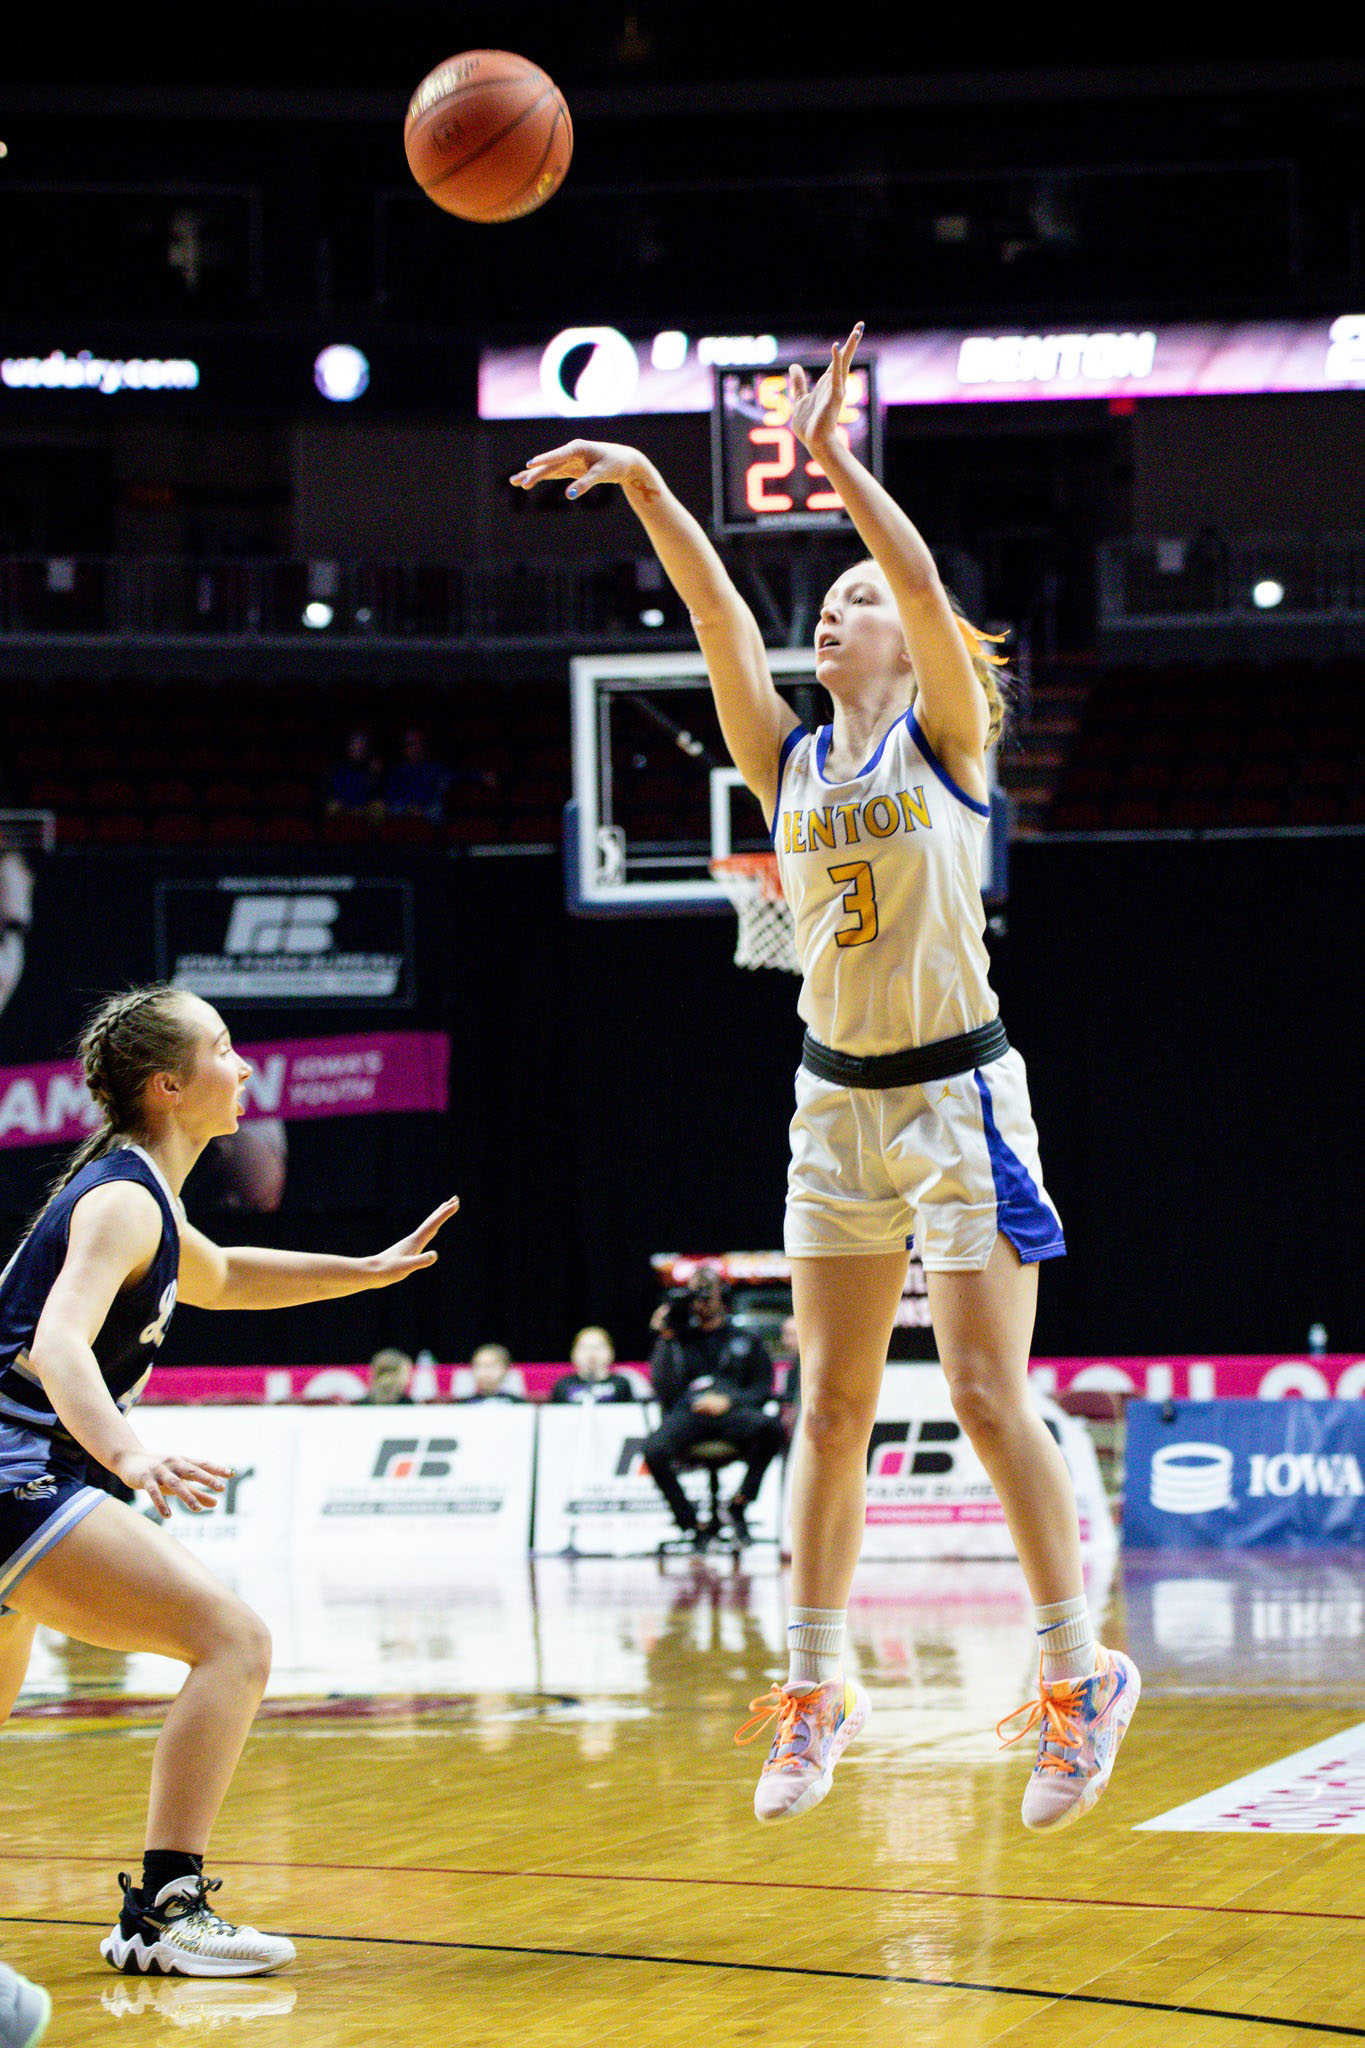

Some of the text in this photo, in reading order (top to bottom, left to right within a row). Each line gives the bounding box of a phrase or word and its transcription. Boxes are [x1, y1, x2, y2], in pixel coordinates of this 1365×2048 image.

[957, 331, 1157, 383] BENTON
[783, 785, 932, 853] BENTON
[826, 860, 879, 948] 3
[1249, 1454, 1364, 1497] IOWA
